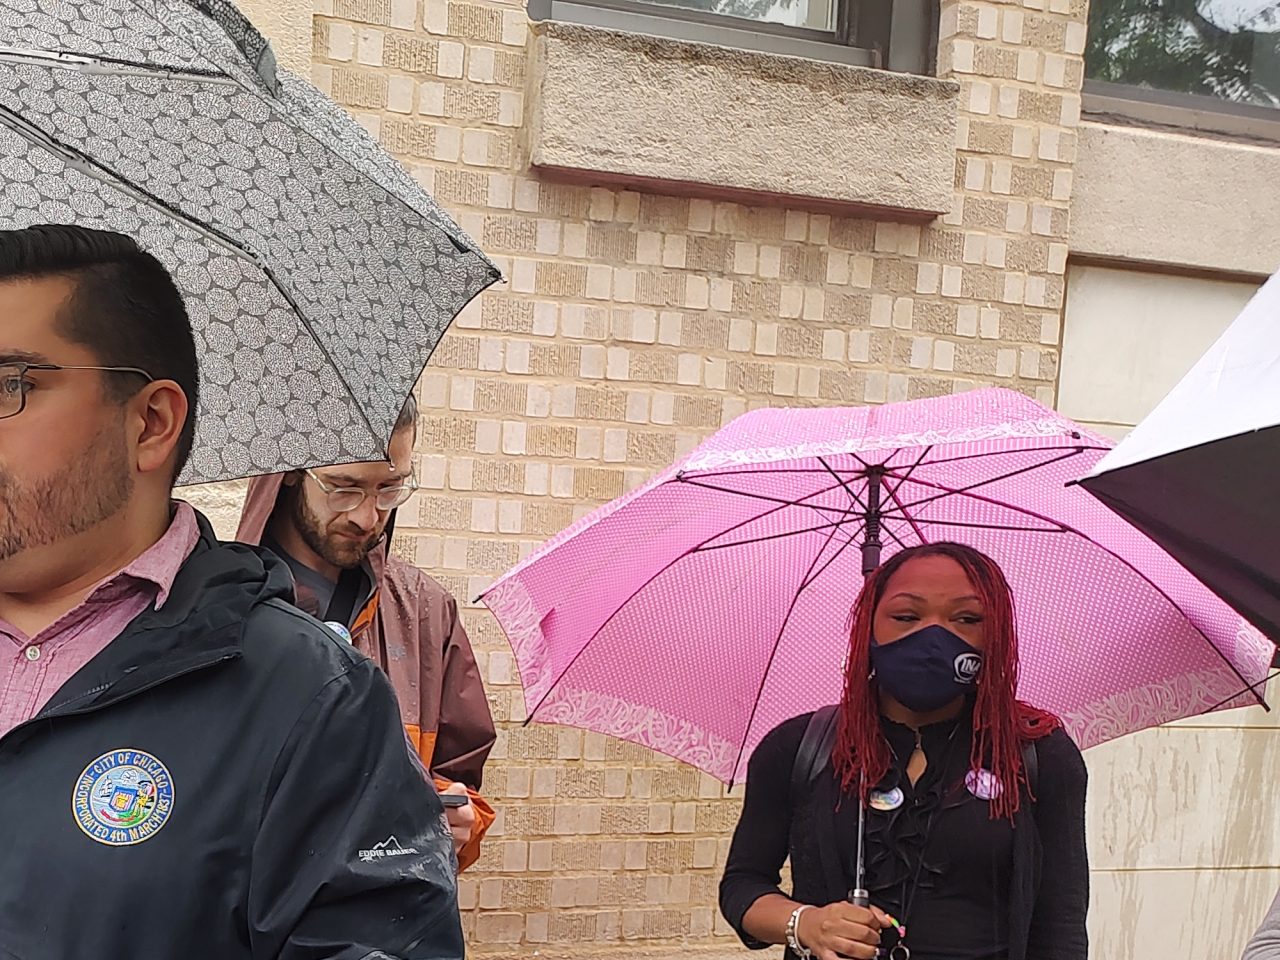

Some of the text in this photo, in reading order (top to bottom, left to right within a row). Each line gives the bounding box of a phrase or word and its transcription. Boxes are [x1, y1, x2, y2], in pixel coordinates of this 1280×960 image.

[93, 752, 169, 789] CITY OF CHICAGO
[76, 774, 109, 838] INCORPORATED
[111, 828, 128, 842] 4th
[129, 812, 163, 842] MARCH
[358, 848, 419, 858] EDDIE BAUER
